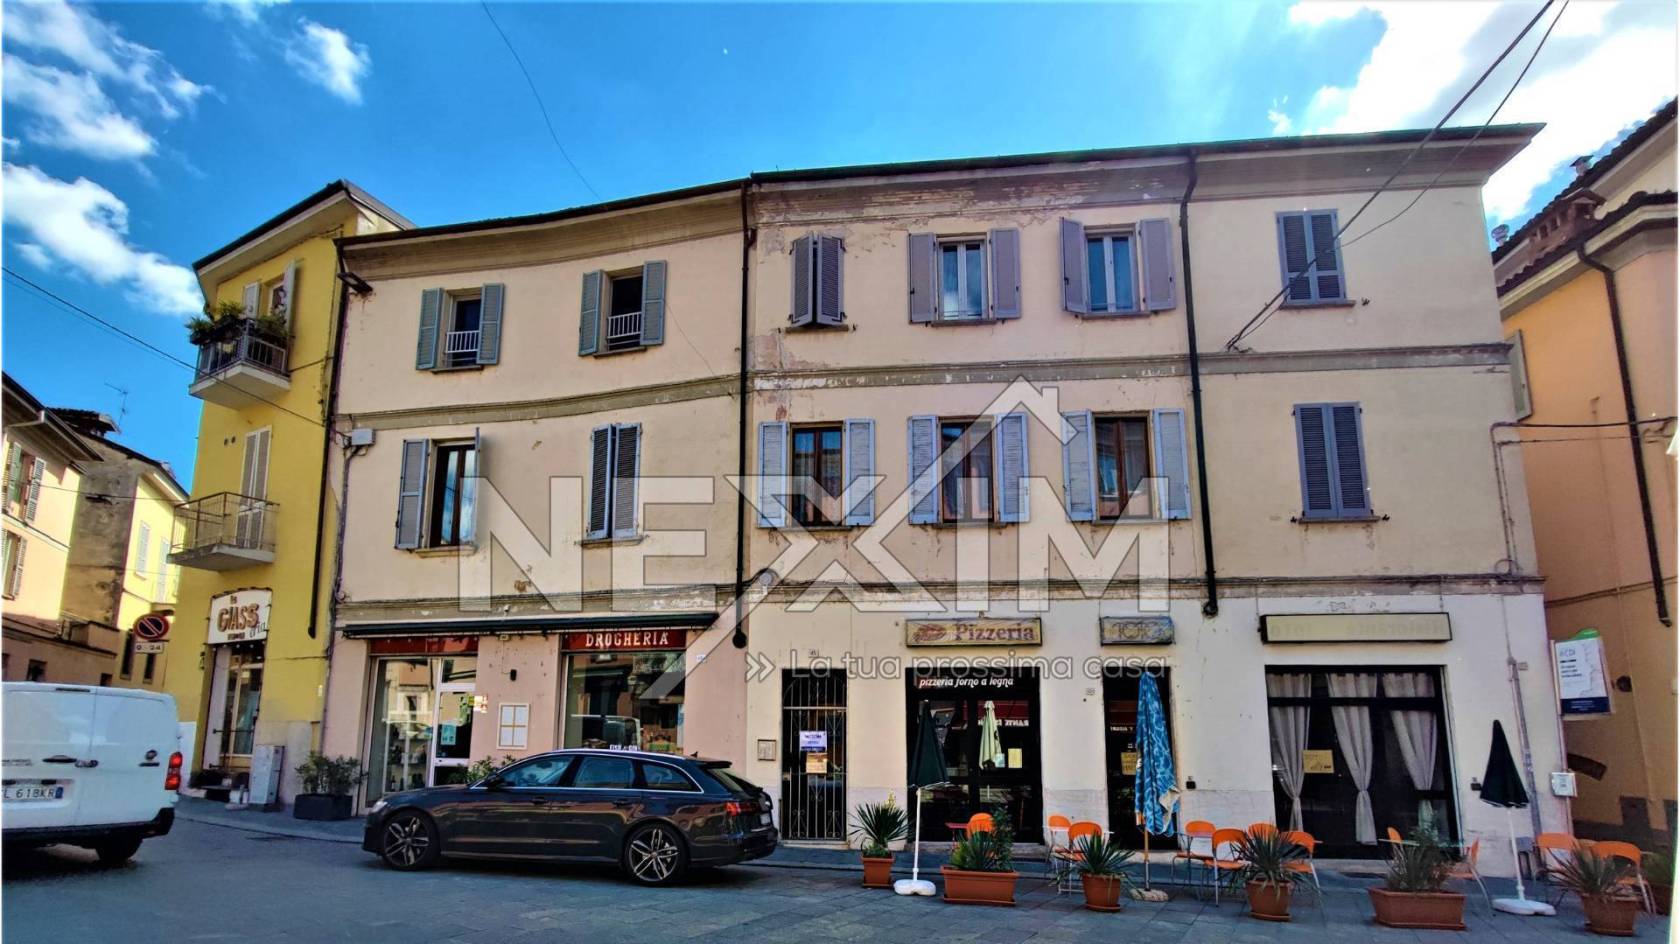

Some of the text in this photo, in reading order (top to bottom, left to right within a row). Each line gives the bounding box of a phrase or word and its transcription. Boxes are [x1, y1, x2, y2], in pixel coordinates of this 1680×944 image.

[585, 631, 669, 648] DROGHERIA
[952, 622, 1035, 641] Pizzeria
[919, 676, 1014, 688] pizzeria forno a legna
